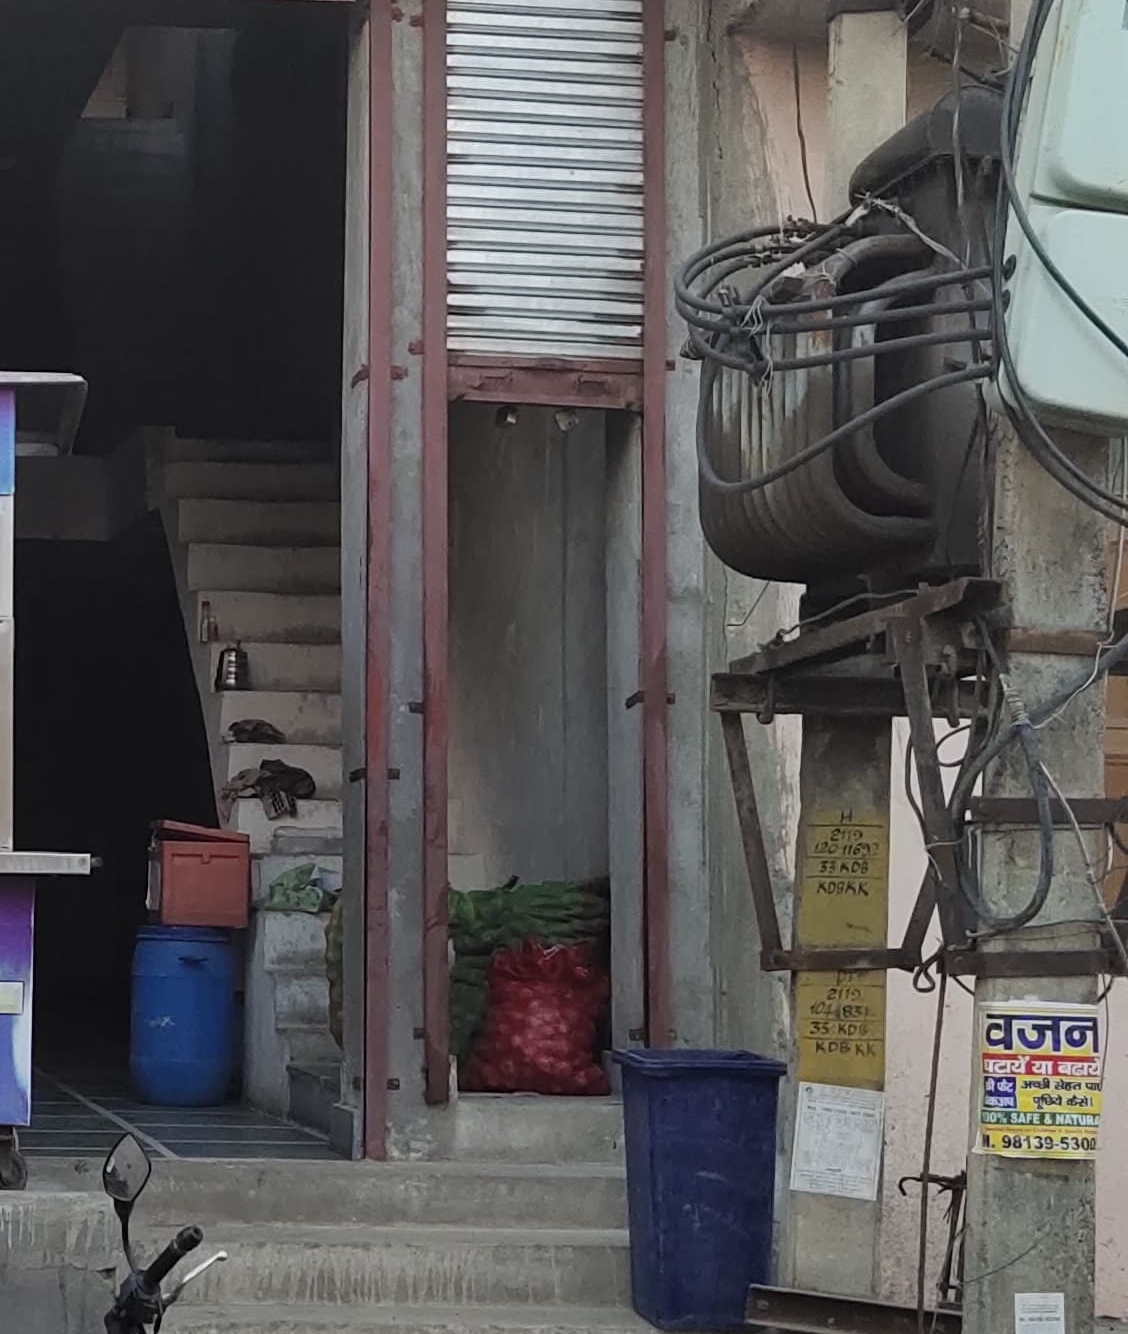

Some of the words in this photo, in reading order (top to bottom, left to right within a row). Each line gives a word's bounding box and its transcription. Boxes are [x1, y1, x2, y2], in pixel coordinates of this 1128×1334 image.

[985, 1013, 1100, 1054] वजन
[1031, 1059, 1054, 1075] या
[1054, 1078, 1082, 1091] सेहत
[1010, 1113, 1041, 1125] SAFE
[1043, 1113, 1053, 1125] &
